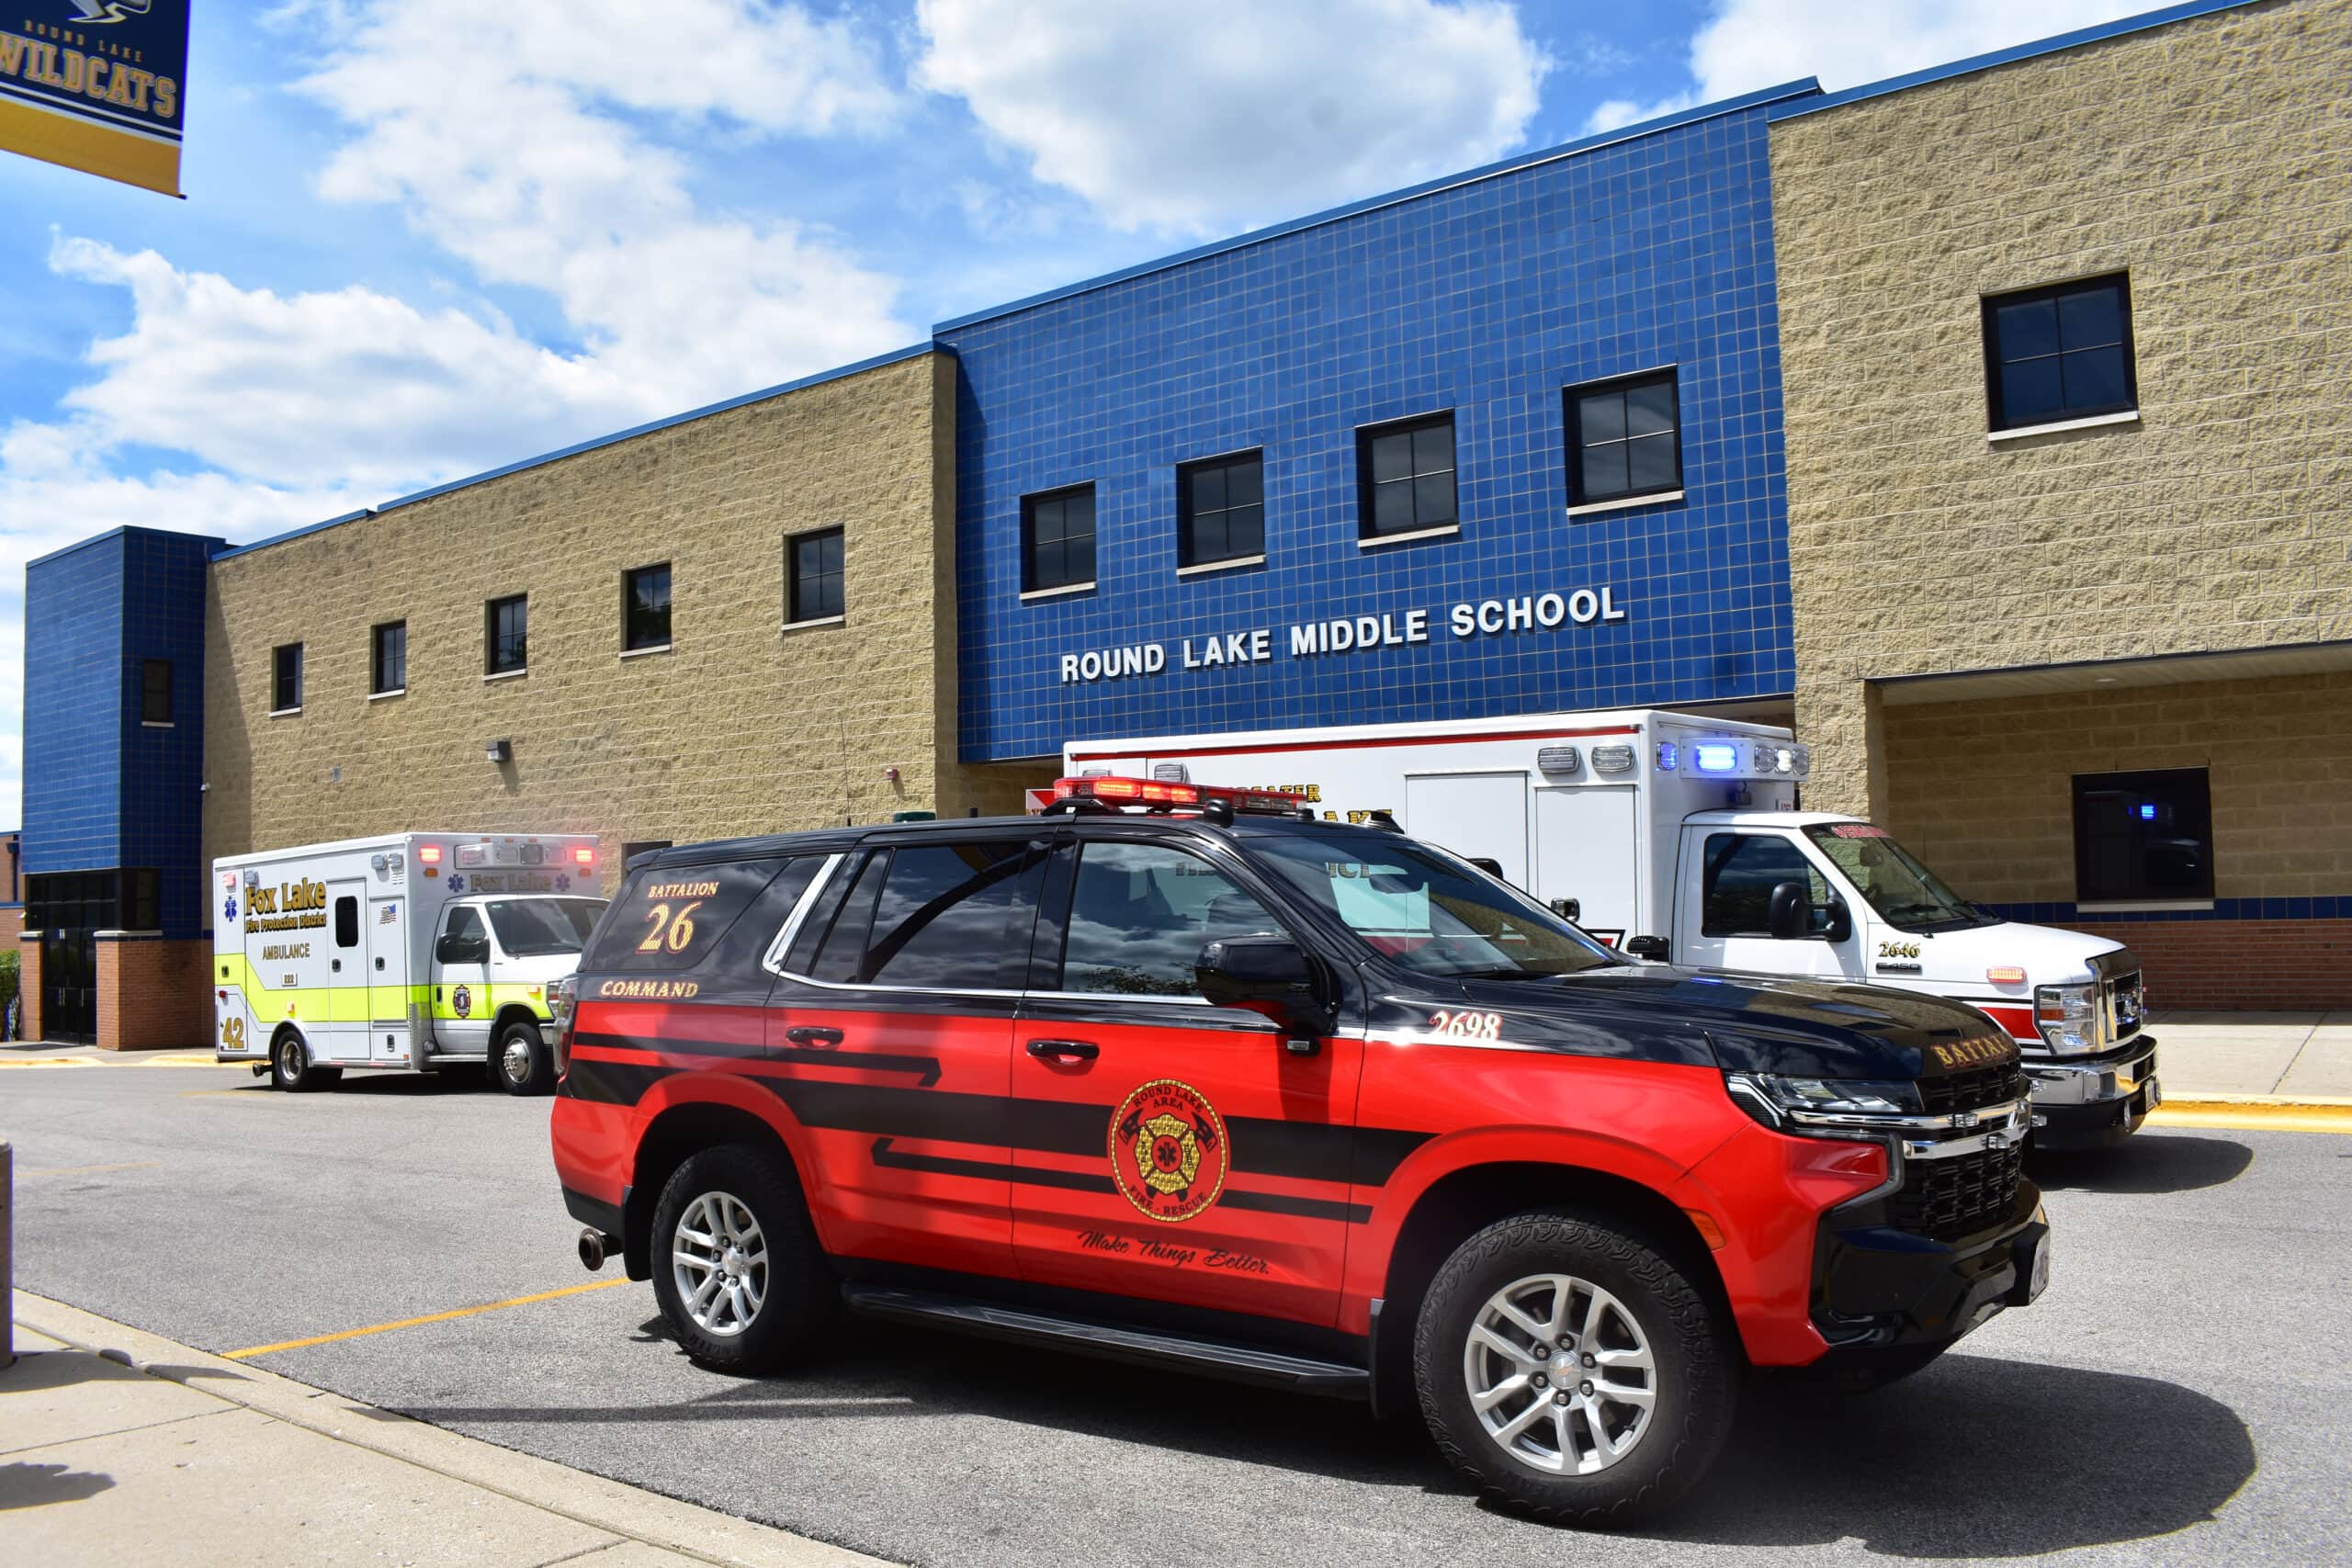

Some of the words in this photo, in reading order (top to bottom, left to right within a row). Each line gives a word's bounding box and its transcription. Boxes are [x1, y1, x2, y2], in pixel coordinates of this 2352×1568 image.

[25, 19, 85, 46] ROUND
[98, 39, 142, 62] LAKE
[0, 30, 176, 118] WILDCATS
[1061, 643, 1165, 683] ROUND
[1183, 629, 1272, 669] LAKE
[1291, 609, 1429, 656] MIDDLE
[1451, 586, 1625, 637] SCHOOL
[245, 886, 277, 916] Fox
[281, 876, 327, 912] Lake
[470, 874, 503, 892] Fox
[507, 872, 552, 892] Lake
[647, 881, 719, 900] BATTALION
[245, 918, 260, 934] Fire
[260, 914, 299, 932] Protection
[299, 911, 327, 930] District
[635, 900, 703, 954] 26
[262, 942, 311, 961] AMBULANCE
[1878, 941, 1921, 958] 2646
[600, 979, 699, 1000] COMMAND
[222, 1017, 244, 1049] 42
[1430, 1010, 1503, 1041] 2698
[1930, 1033, 2012, 1069] BATTAL
[1133, 1086, 1171, 1109] ROUND
[1175, 1088, 1204, 1112] LAKE
[1153, 1096, 1183, 1111] AREA
[1130, 1185, 1154, 1209] FIRE
[1163, 1191, 1206, 1215] RESCUE
[1078, 1230, 1129, 1253] Make
[1137, 1238, 1196, 1268] Things
[1204, 1247, 1270, 1275] Better.
